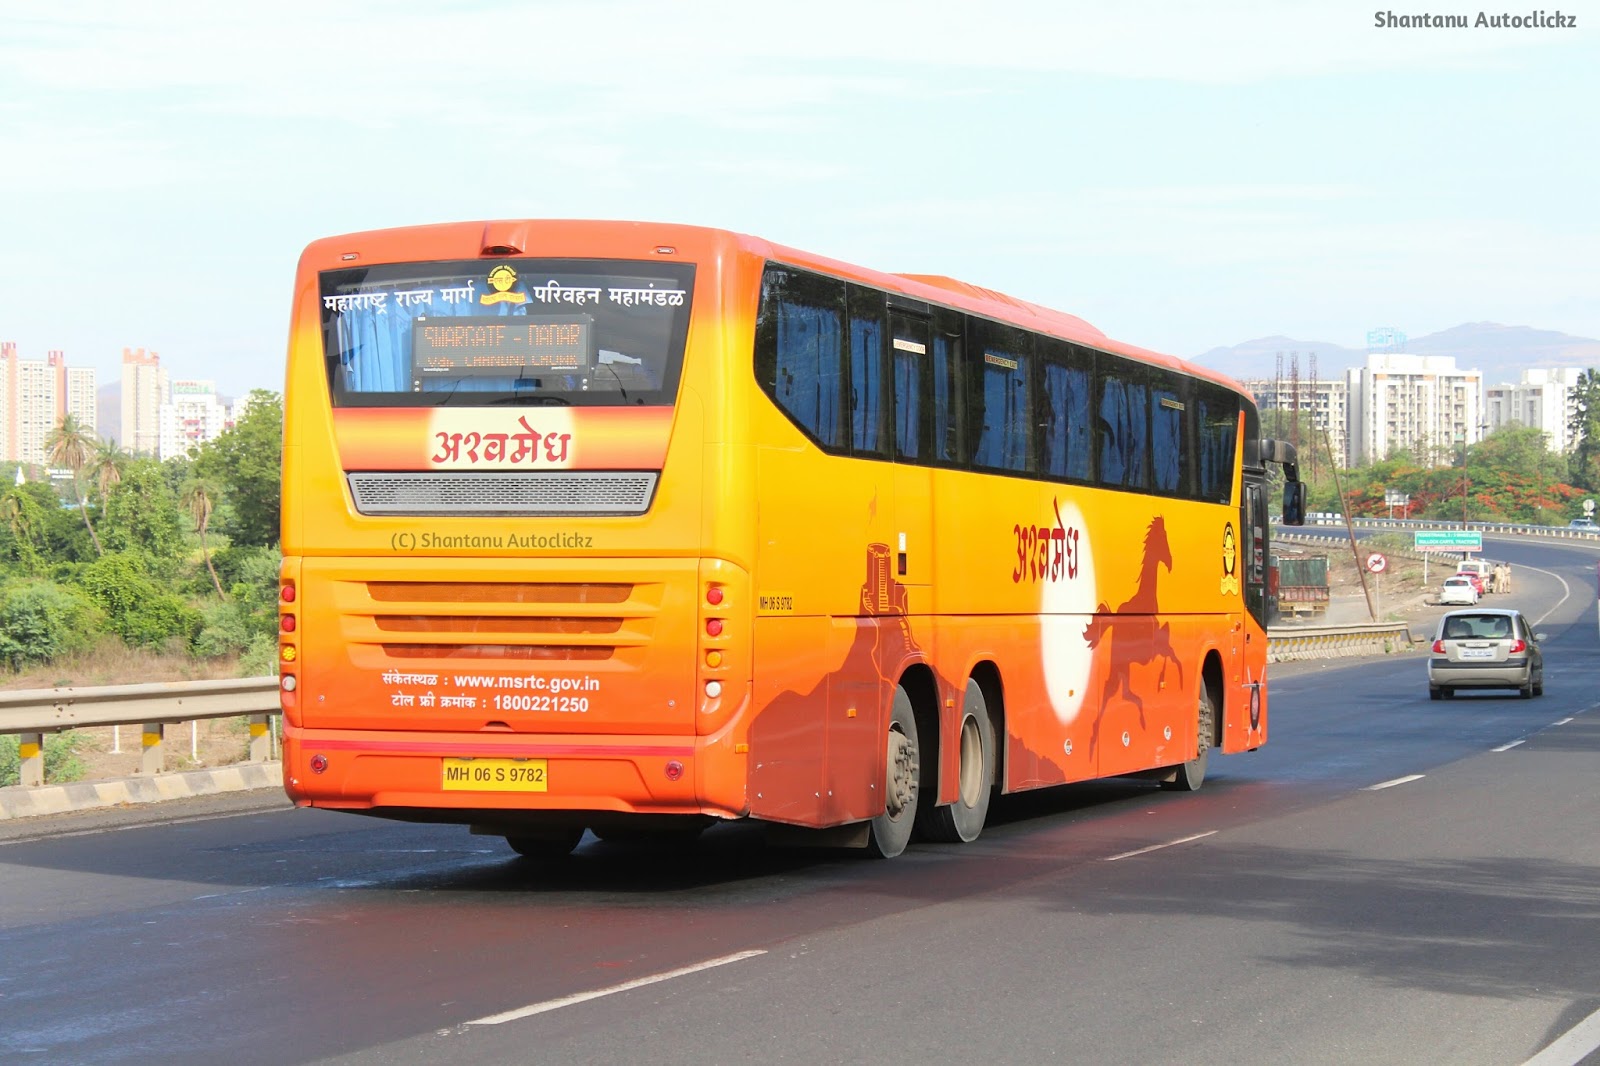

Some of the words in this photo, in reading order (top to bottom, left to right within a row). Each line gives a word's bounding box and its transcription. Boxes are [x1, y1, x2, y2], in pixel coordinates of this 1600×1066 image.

[322, 292, 388, 314] महाराष्ट्र
[394, 290, 434, 307] राज्य
[440, 280, 475, 304] मार्ग
[533, 280, 602, 306] परिवहन
[608, 283, 687, 308] महामंडळ
[760, 596, 768, 610] MH
[769, 596, 775, 610] 06
[382, 669, 438, 686] संकेतस्थळ
[454, 674, 600, 693] www.msrtc.gov.in
[391, 690, 415, 707] टोल
[419, 690, 435, 708] फ्री
[440, 692, 477, 709] क्रमांक
[493, 694, 589, 713] 1800221250
[447, 767, 470, 781] MH
[474, 767, 491, 782] 06
[495, 767, 505, 782] S
[509, 768, 543, 782] 9782
